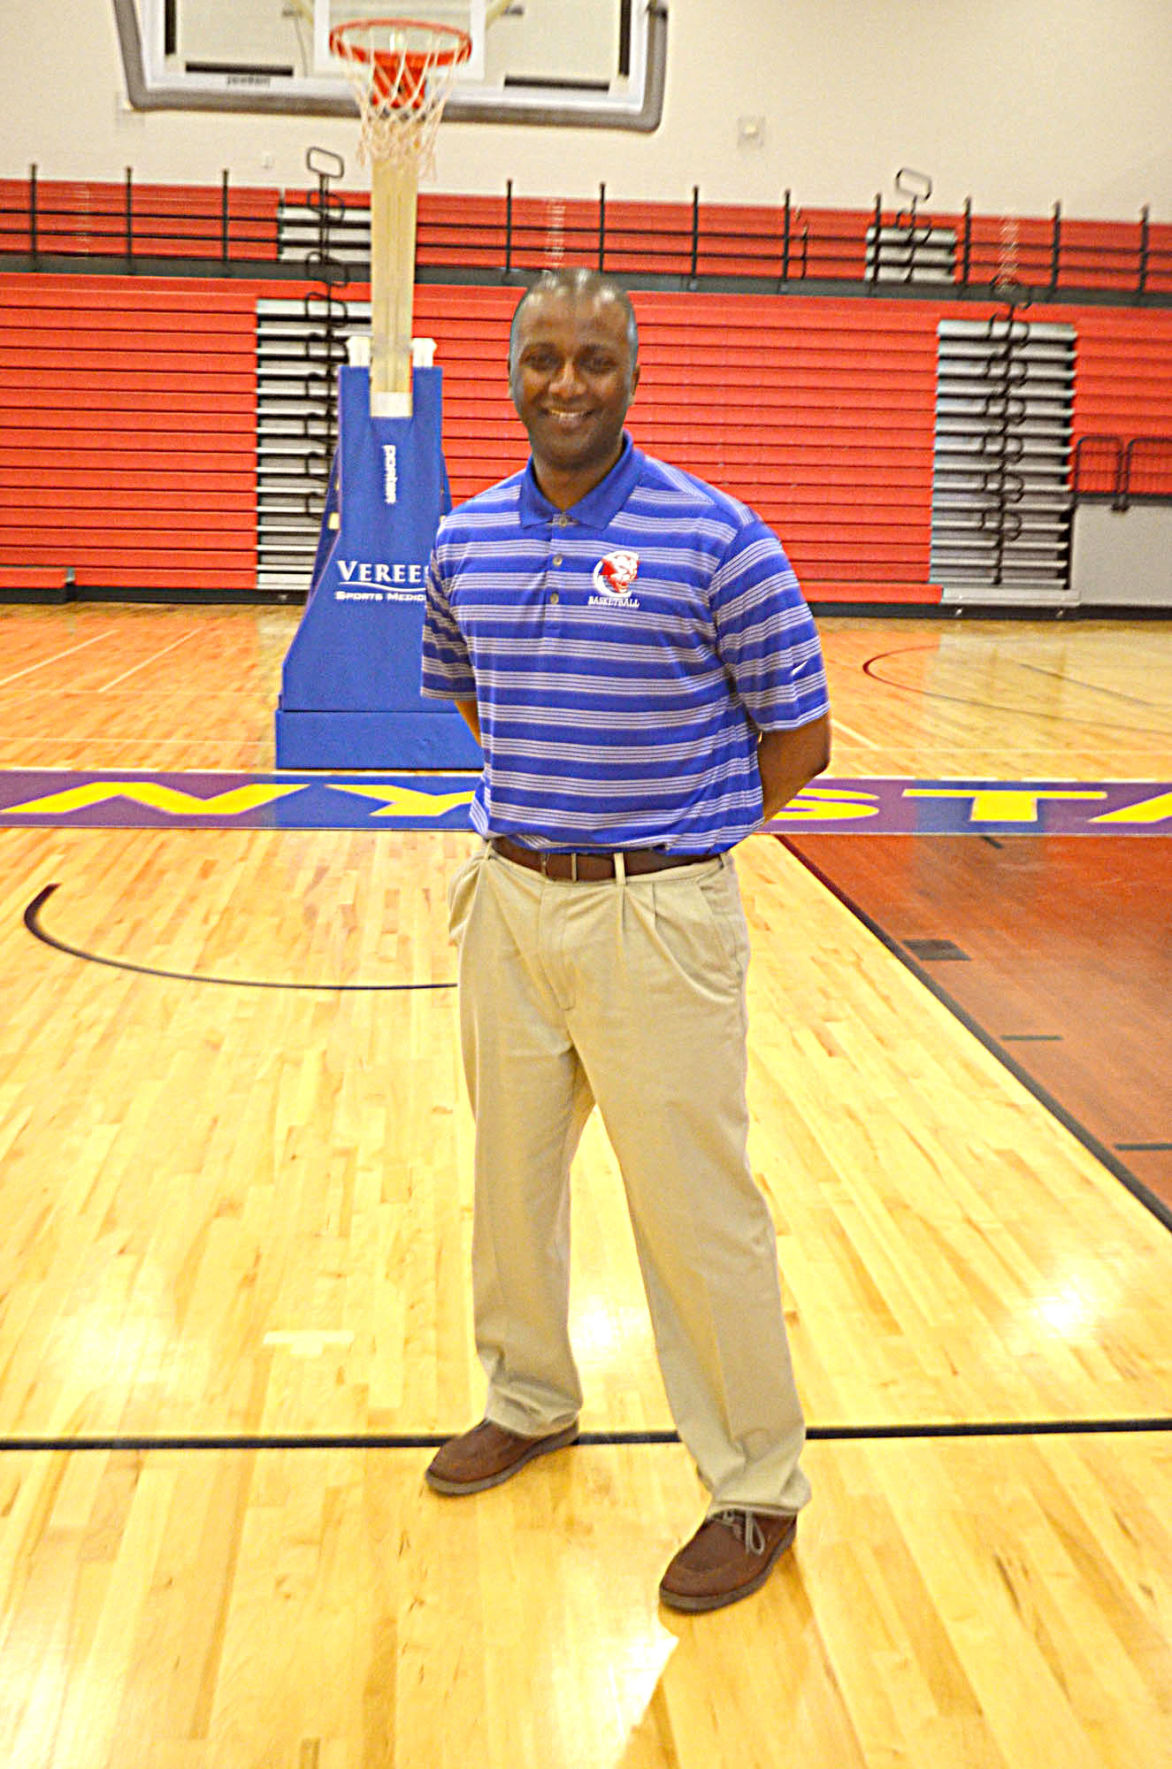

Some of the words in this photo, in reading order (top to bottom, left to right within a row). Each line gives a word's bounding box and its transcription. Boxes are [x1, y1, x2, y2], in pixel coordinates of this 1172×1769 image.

[337, 560, 428, 583] VEREE
[335, 591, 383, 601] SPORTS
[588, 596, 640, 608] BASKETBALL
